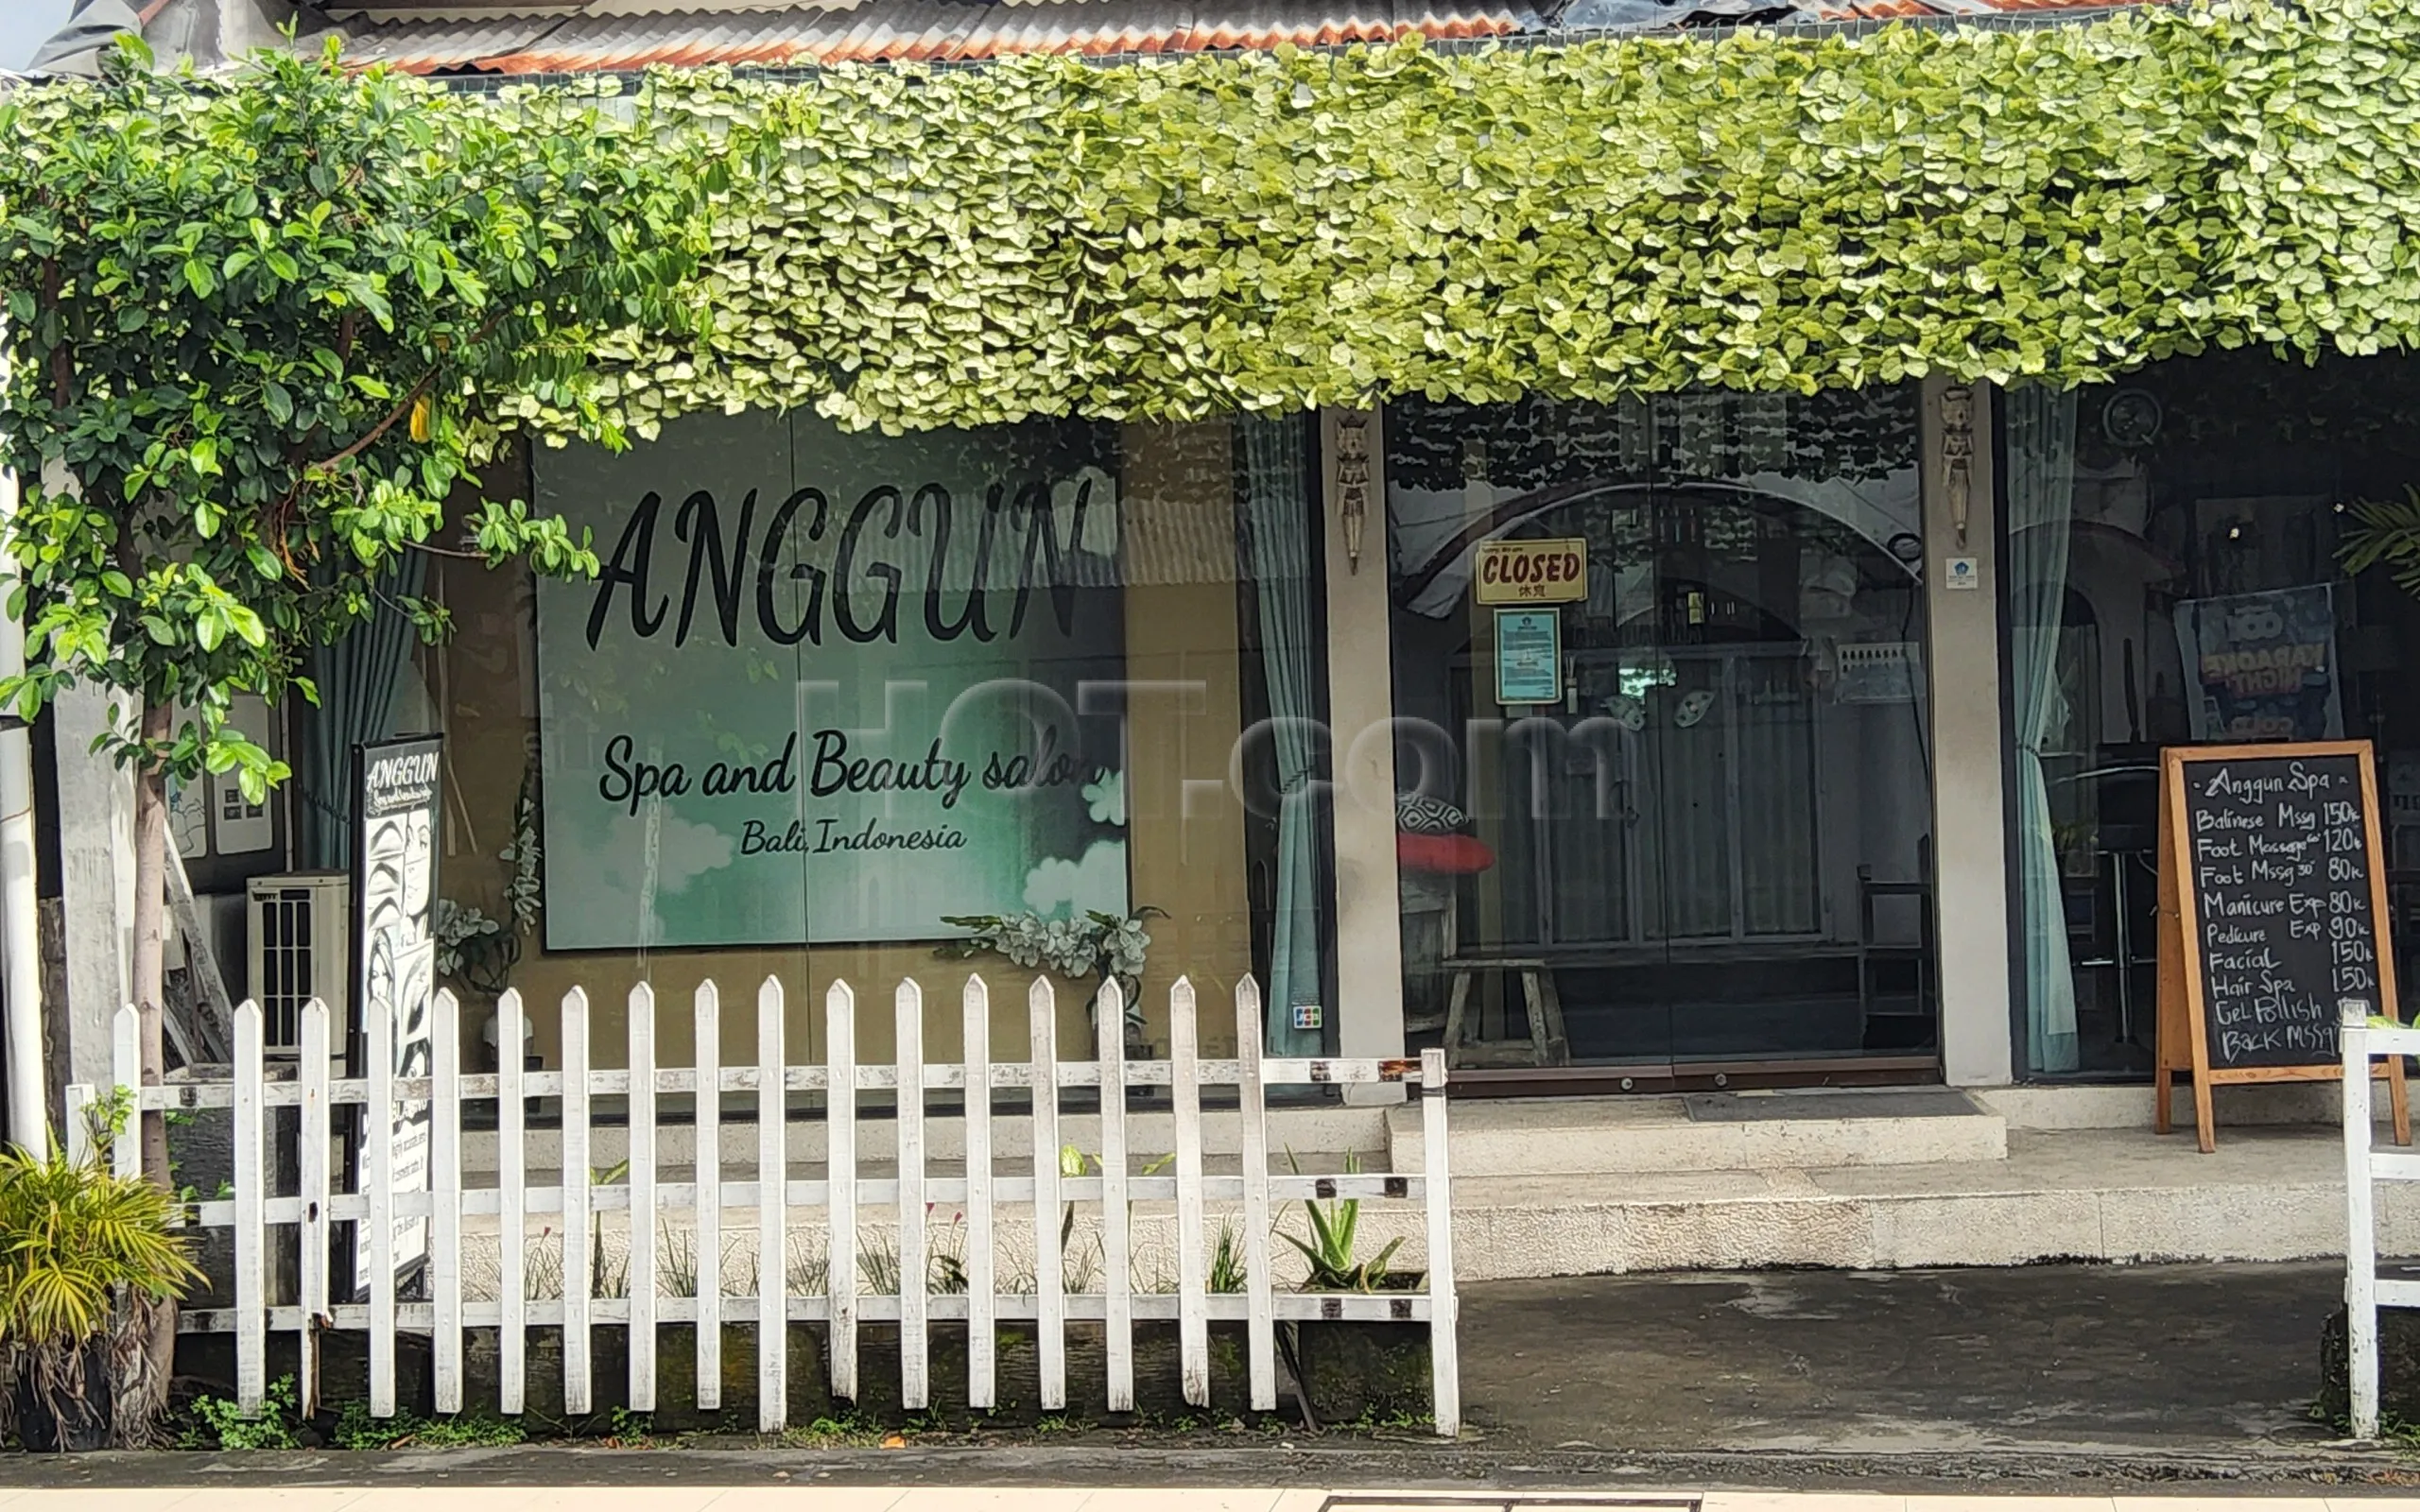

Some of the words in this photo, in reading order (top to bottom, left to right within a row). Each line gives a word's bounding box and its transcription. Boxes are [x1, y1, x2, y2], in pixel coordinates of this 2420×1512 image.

[585, 477, 1092, 651] ANGGUN
[1482, 553, 1581, 584] CLOSED
[366, 750, 440, 793] ANGGUN
[598, 734, 692, 816] Spa
[701, 731, 798, 797] and
[810, 729, 972, 810] Beauty
[2204, 767, 2284, 804] Anggun
[2287, 762, 2330, 799] Spa
[2195, 808, 2265, 833] Balinese
[2278, 802, 2316, 830] Mssg
[2196, 837, 2244, 862] Foot
[2200, 865, 2244, 888] Foot
[2251, 859, 2295, 886] Mssg
[2204, 891, 2285, 919] Manicure
[2206, 922, 2268, 947] Pedicure
[2211, 974, 2254, 999] Hair
[2258, 970, 2296, 1000] Spa
